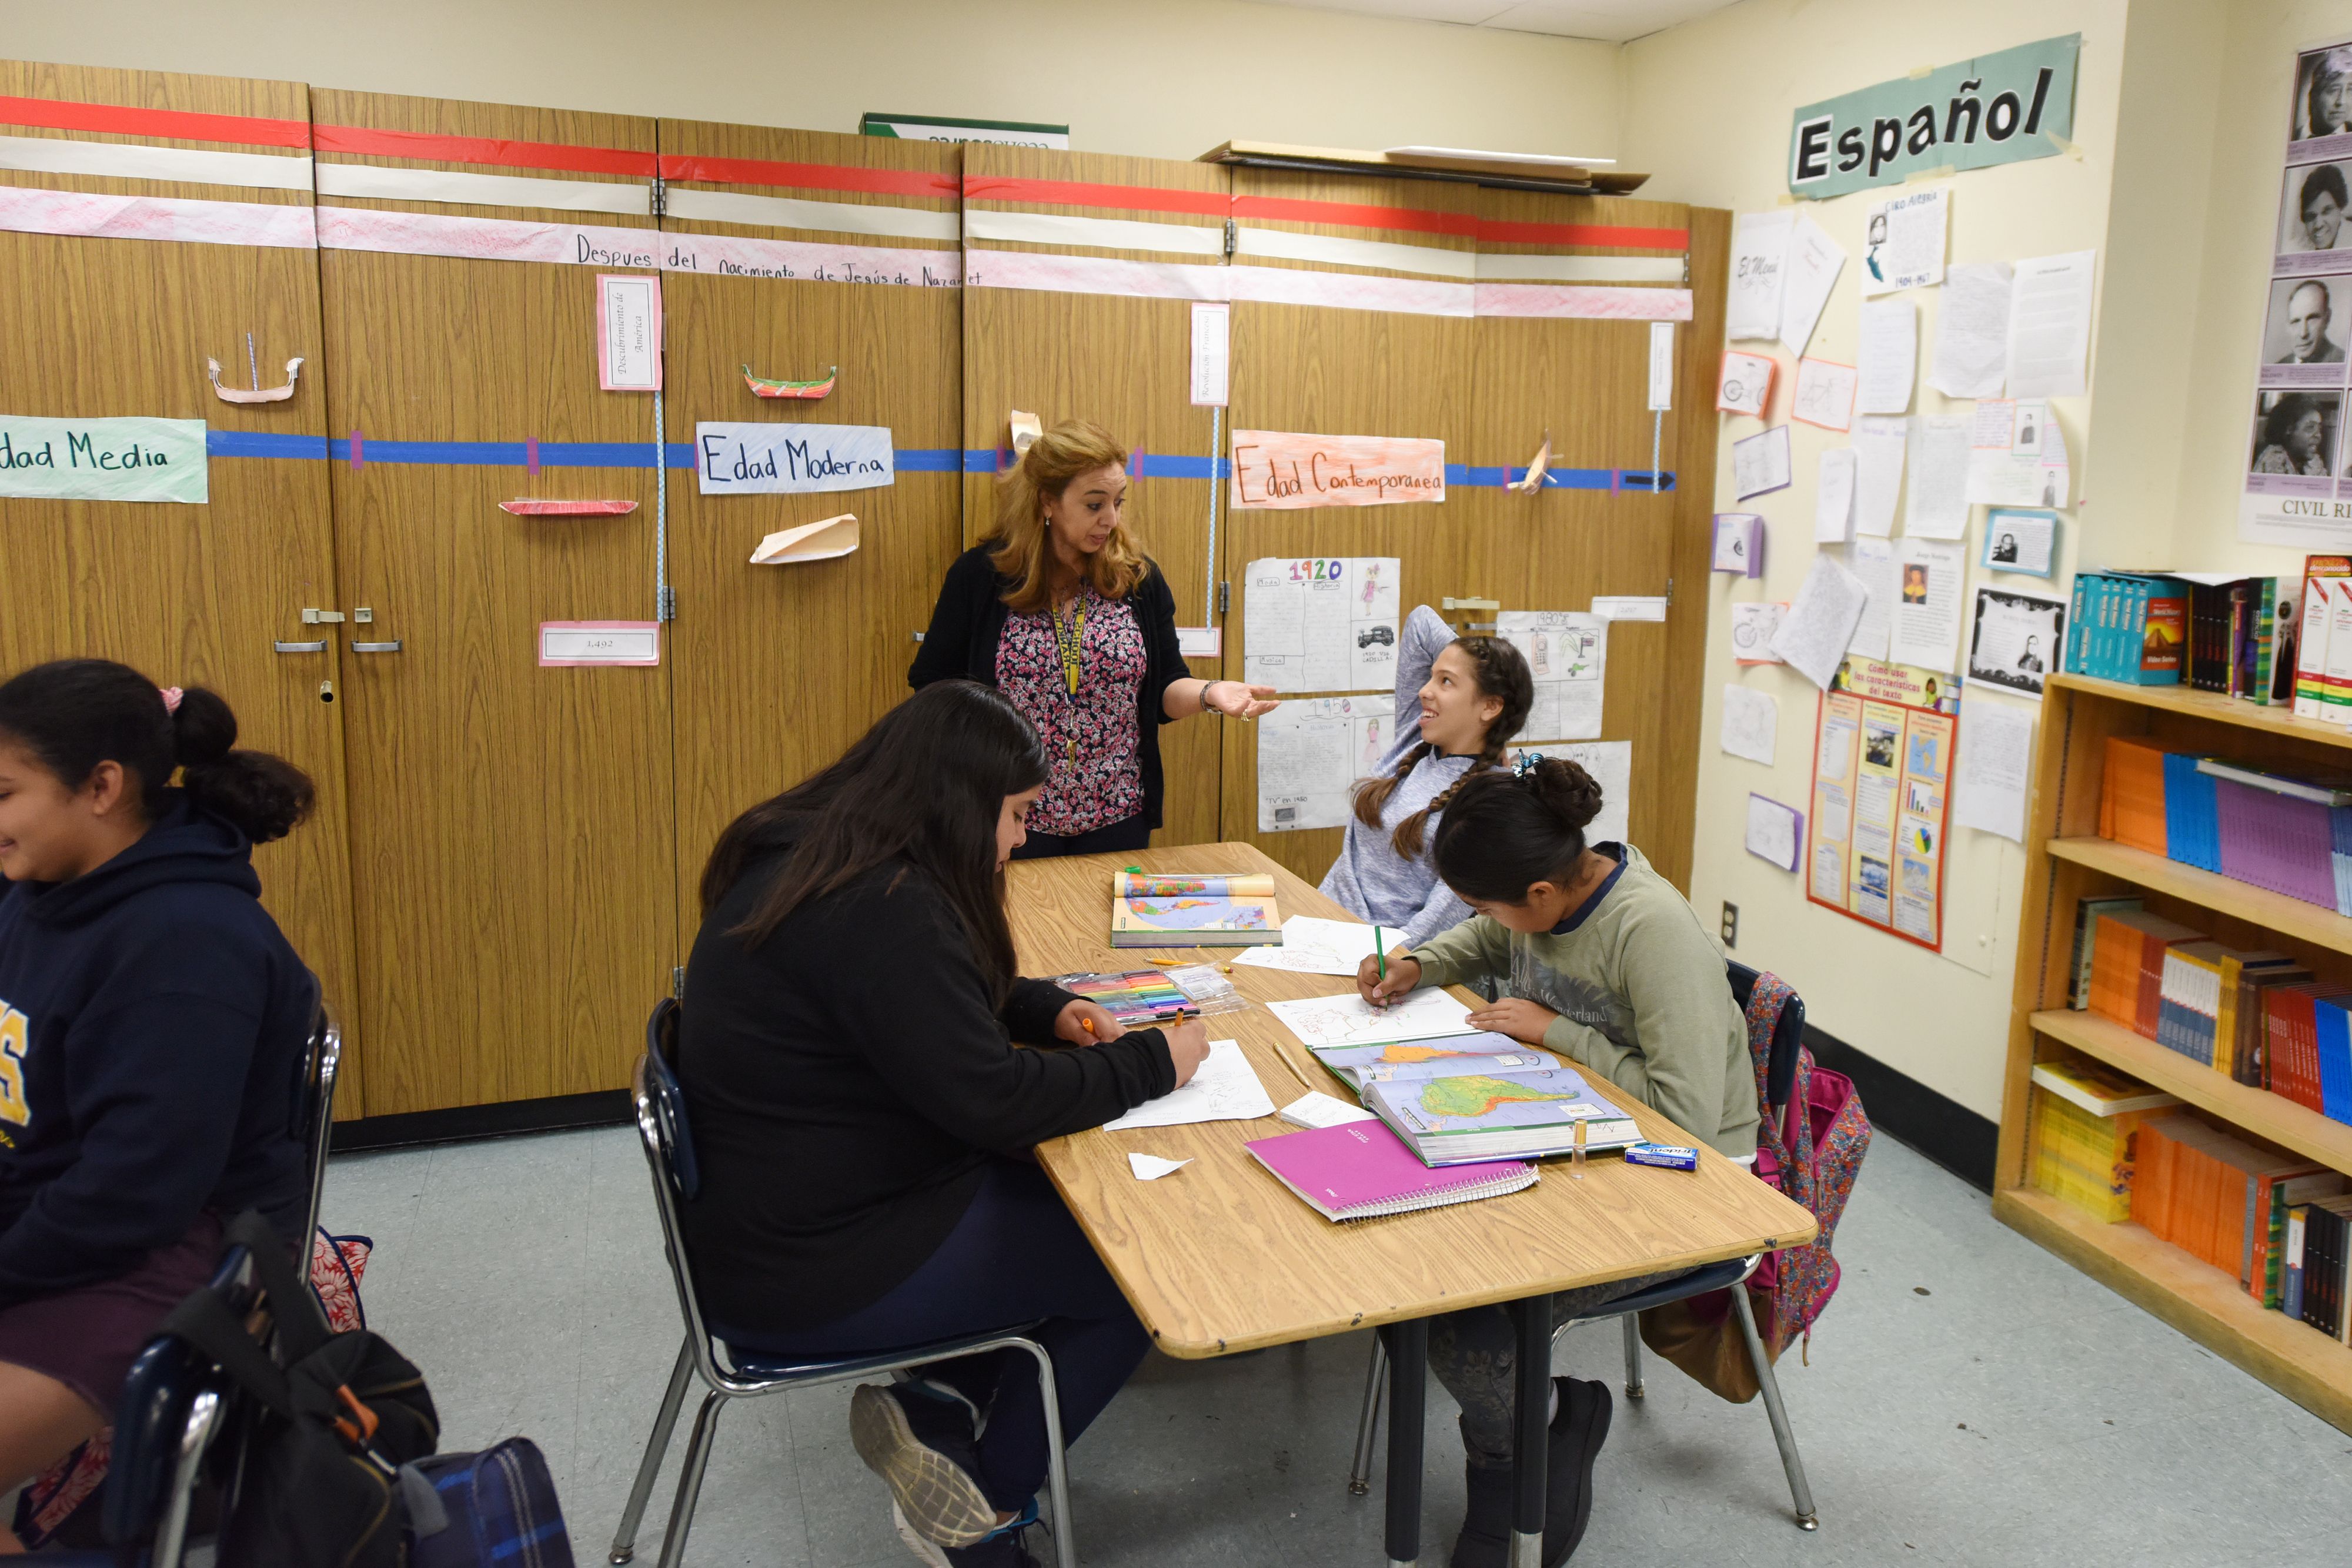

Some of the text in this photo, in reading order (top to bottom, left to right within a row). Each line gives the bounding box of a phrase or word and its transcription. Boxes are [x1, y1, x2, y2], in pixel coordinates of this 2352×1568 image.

[1796, 67, 2053, 180] Español
[577, 233, 652, 266] Despues
[668, 247, 697, 269] del
[719, 259, 794, 279] nacimiento
[814, 266, 835, 282] de
[843, 262, 889, 285] Jesús
[894, 271, 911, 286] de
[612, 292, 627, 375] Descubrimiento de
[632, 315, 644, 353] América
[1200, 315, 1210, 397] Revolución Francesa
[67, 430, 168, 470] Media
[703, 434, 884, 482] Edad Moderna
[1235, 445, 1442, 504] Edad Contemporanea
[2282, 500, 2328, 517] CIVIL
[1289, 560, 1342, 581] 1920
[586, 640, 613, 649] 1,492
[1854, 671, 1865, 683] las
[1892, 668, 1908, 678] usar
[1305, 698, 1351, 717] 1950
[1869, 687, 1903, 700] del texto
